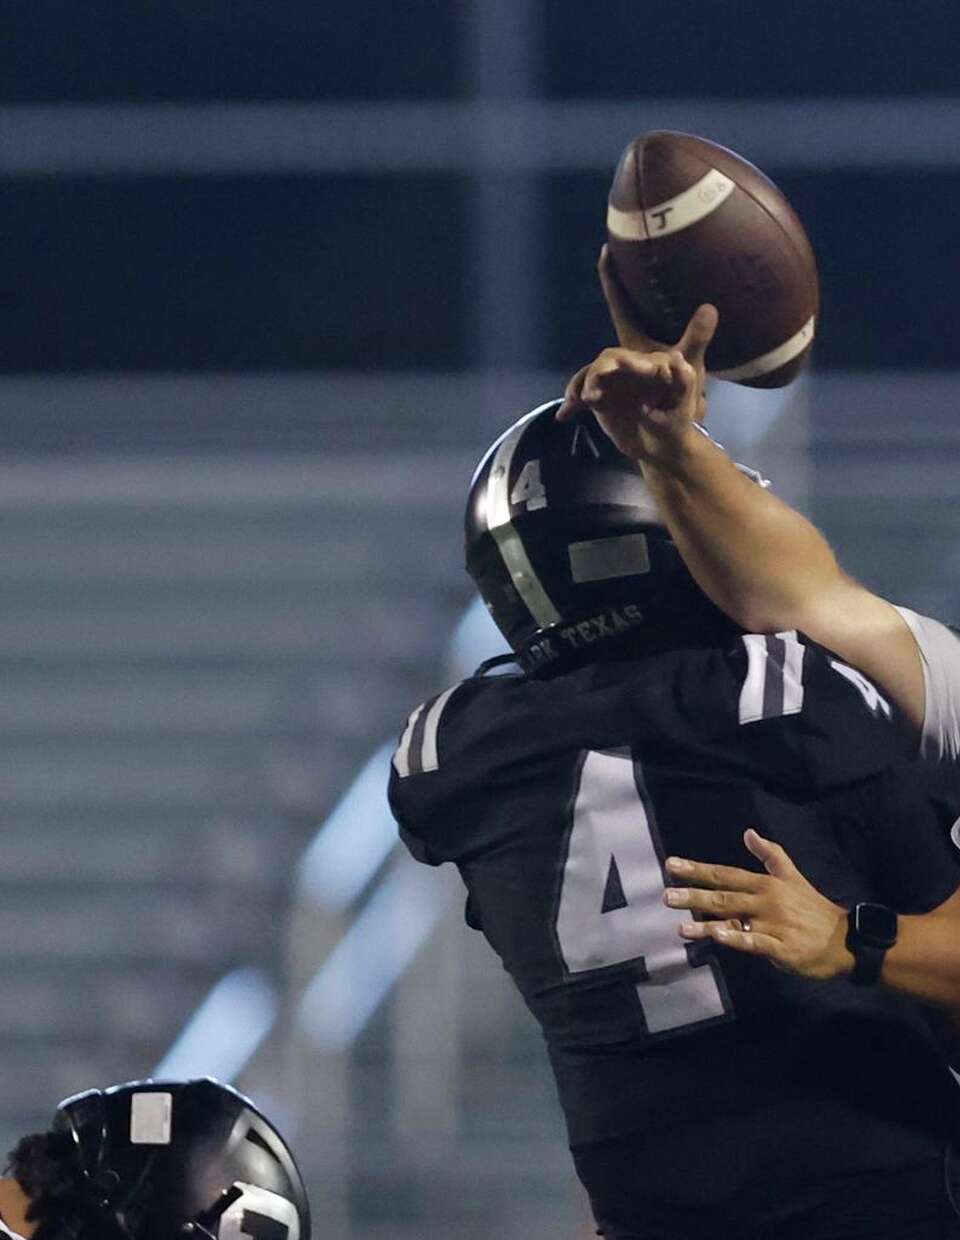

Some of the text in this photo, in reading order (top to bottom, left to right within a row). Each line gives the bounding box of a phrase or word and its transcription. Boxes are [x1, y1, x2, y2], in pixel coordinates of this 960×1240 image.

[510, 458, 548, 512] 4
[561, 603, 643, 649] TEXAS
[555, 748, 730, 1037] 4
